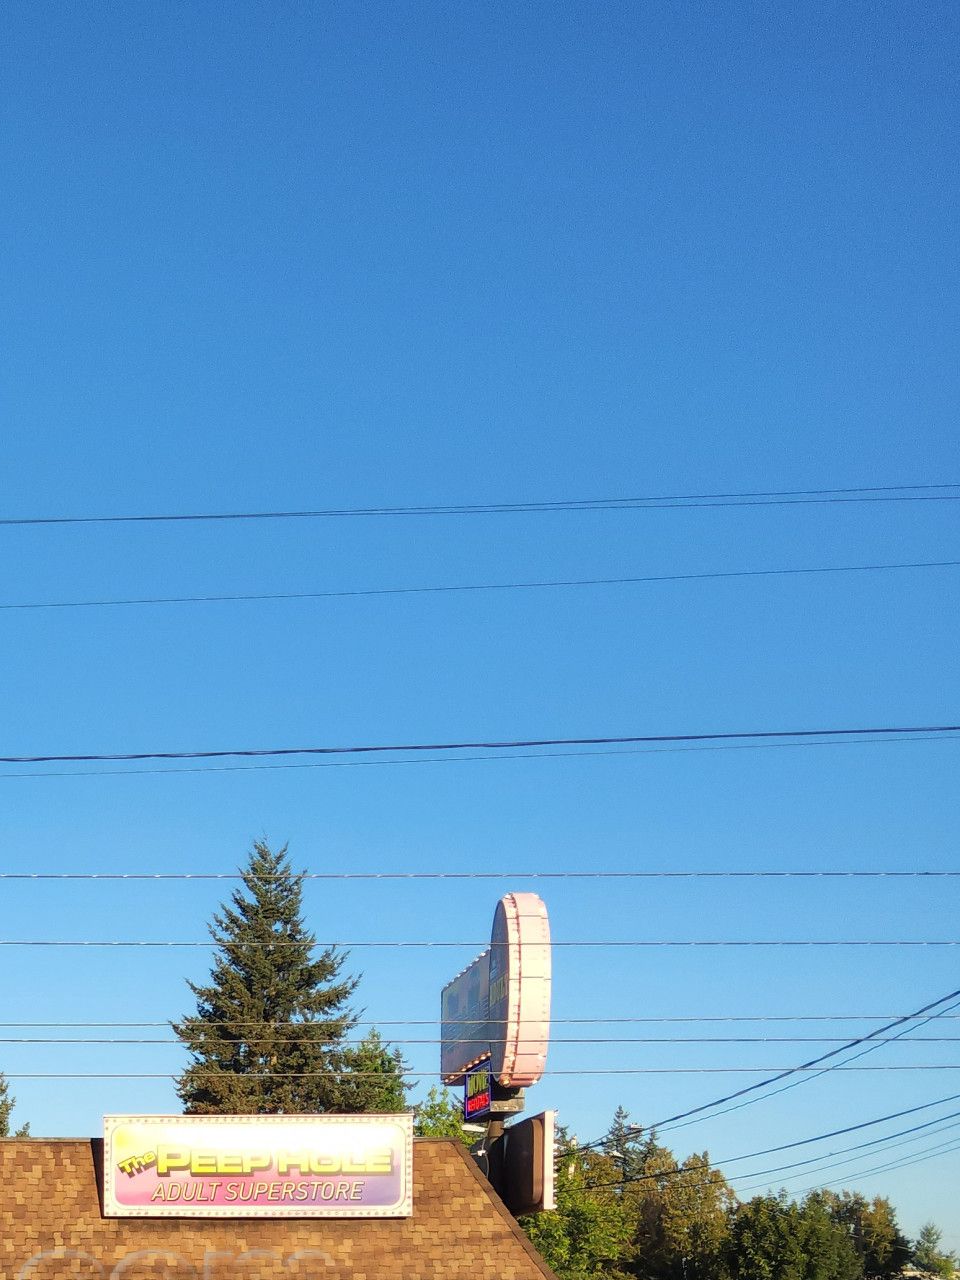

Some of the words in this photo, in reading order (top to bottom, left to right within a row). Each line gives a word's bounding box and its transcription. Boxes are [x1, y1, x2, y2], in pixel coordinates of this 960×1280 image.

[117, 1152, 156, 1177] The
[155, 1145, 272, 1176] PEEP
[277, 1148, 393, 1176] HOLE
[150, 1182, 221, 1201] ADULT
[225, 1182, 365, 1201] SUPERSTORE
